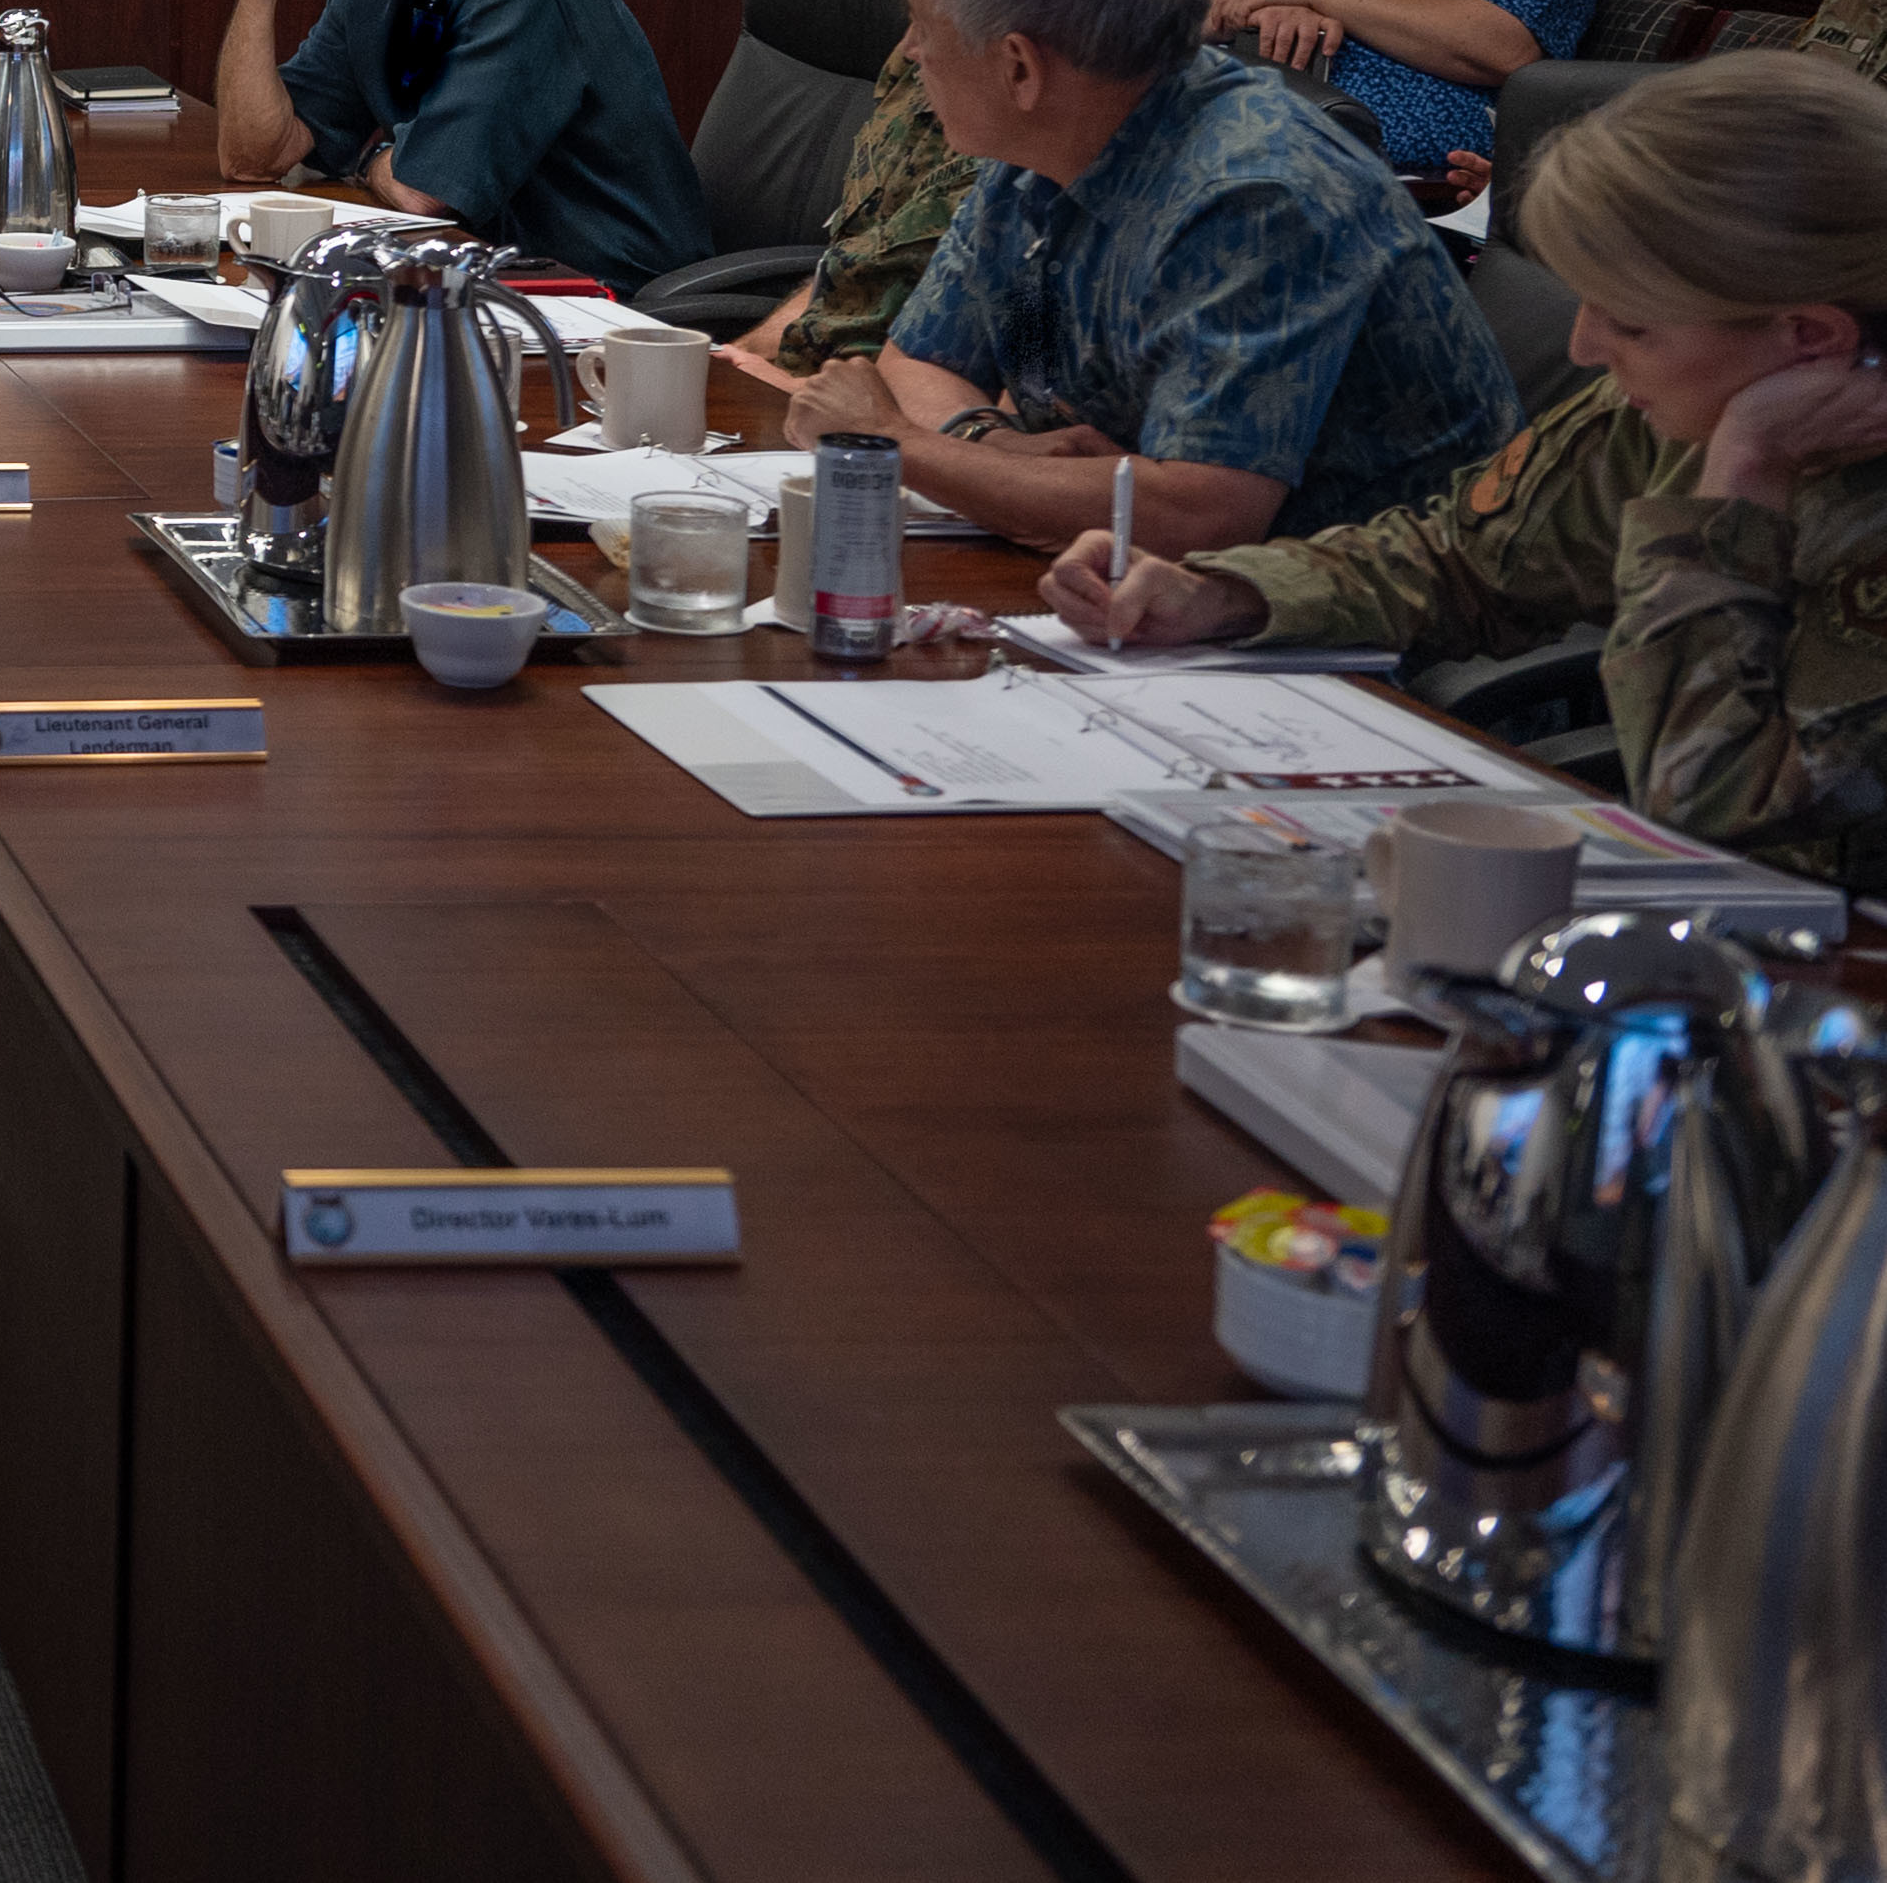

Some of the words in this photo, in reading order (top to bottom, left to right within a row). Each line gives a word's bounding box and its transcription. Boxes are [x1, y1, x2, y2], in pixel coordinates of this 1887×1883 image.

[34, 718, 134, 733] Lieutenant
[137, 715, 210, 731] General
[69, 739, 174, 754] Lenderman
[409, 1206, 517, 1232] Director
[523, 1206, 670, 1231] Vares-Lum
